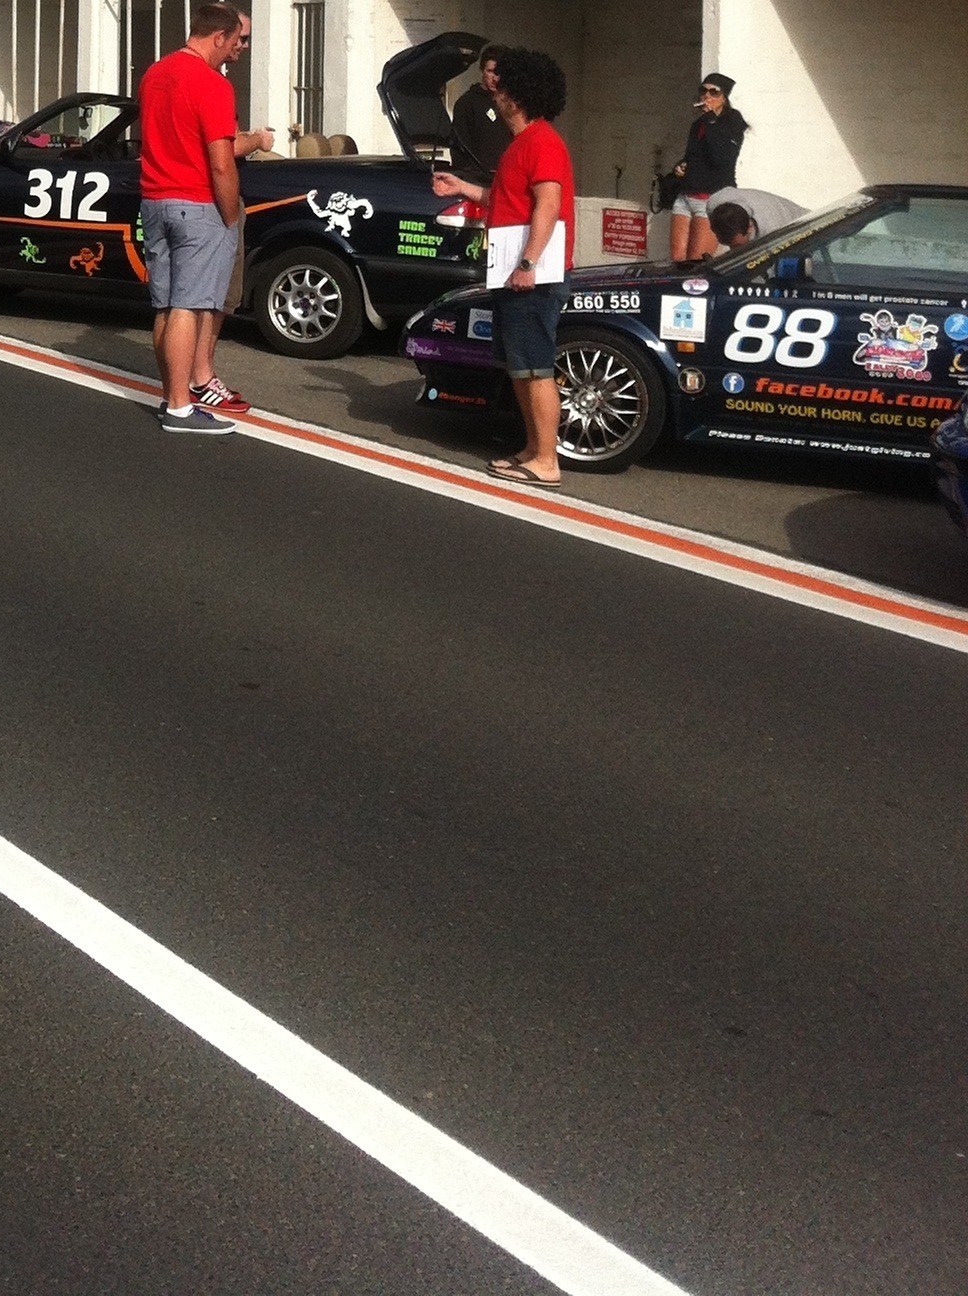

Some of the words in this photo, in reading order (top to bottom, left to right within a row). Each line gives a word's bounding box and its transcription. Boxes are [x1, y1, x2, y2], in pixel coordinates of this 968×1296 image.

[23, 168, 111, 222] 312
[398, 232, 443, 246] TRACEY
[574, 296, 604, 310] 660
[610, 294, 640, 309] 550
[723, 304, 836, 368] 88
[725, 398, 775, 415] SOUND
[778, 403, 818, 420] YOUR
[869, 413, 902, 426] GIVE
[907, 415, 927, 428] US
